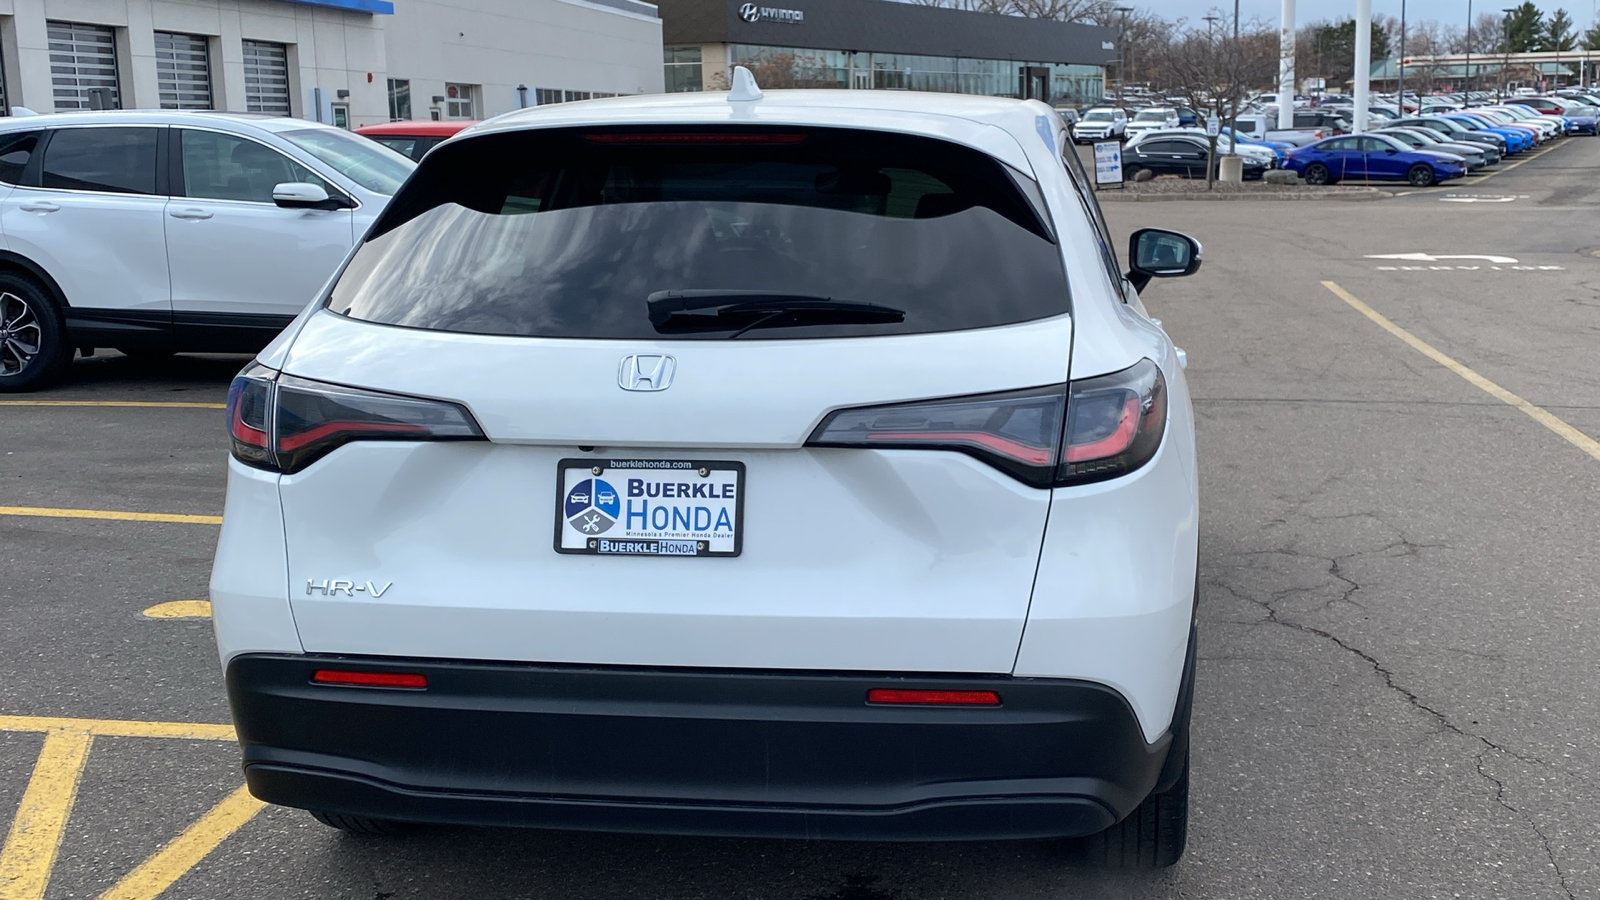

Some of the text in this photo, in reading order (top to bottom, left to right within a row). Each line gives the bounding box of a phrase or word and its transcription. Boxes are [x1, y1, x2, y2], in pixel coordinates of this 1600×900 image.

[761, 7, 803, 20] HYUNDAI
[610, 460, 692, 469] buerklehonda.com
[627, 478, 735, 498] BUERKLE
[626, 499, 733, 531] HONDA
[306, 578, 393, 598] HR-V
